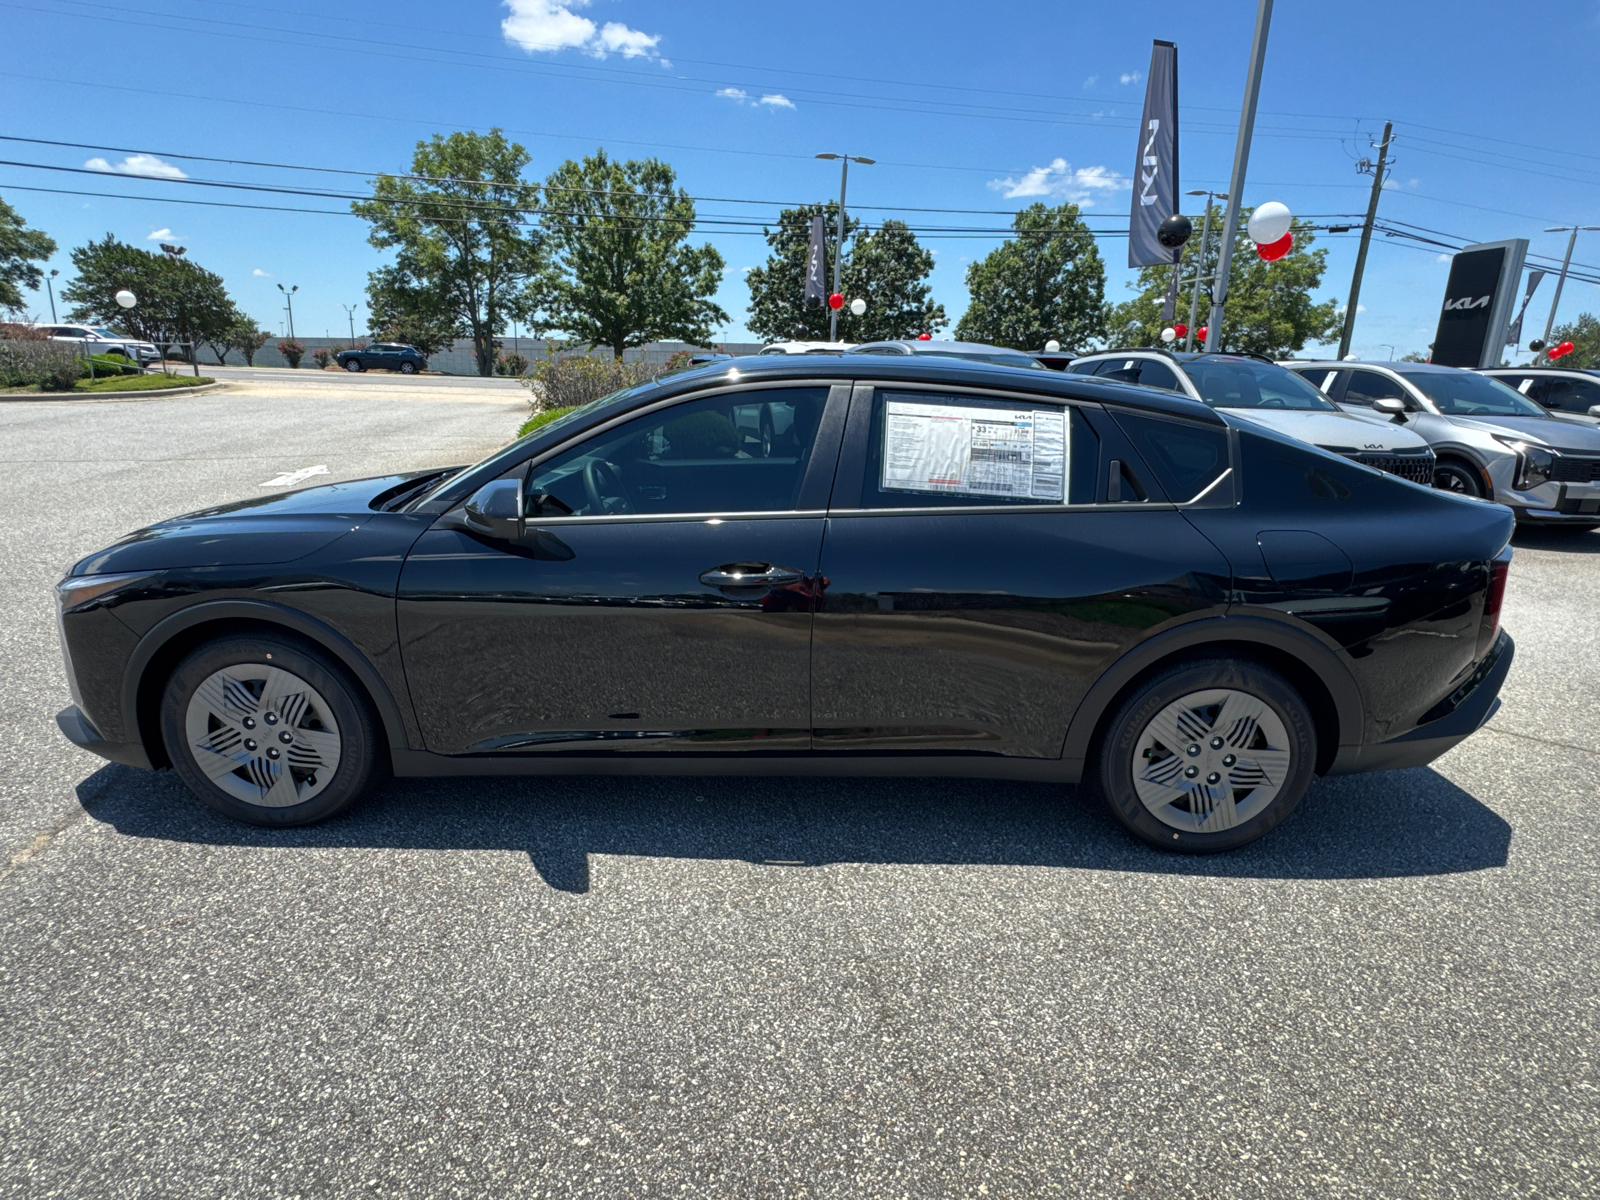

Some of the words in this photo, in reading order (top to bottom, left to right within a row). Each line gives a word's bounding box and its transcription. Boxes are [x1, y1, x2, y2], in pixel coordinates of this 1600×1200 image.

[1140, 119, 1160, 206] KIA
[1444, 295, 1490, 311] KIA
[976, 425, 987, 433] 33
[1120, 695, 1161, 748] KUMHO
[338, 735, 358, 790] KUMHO
